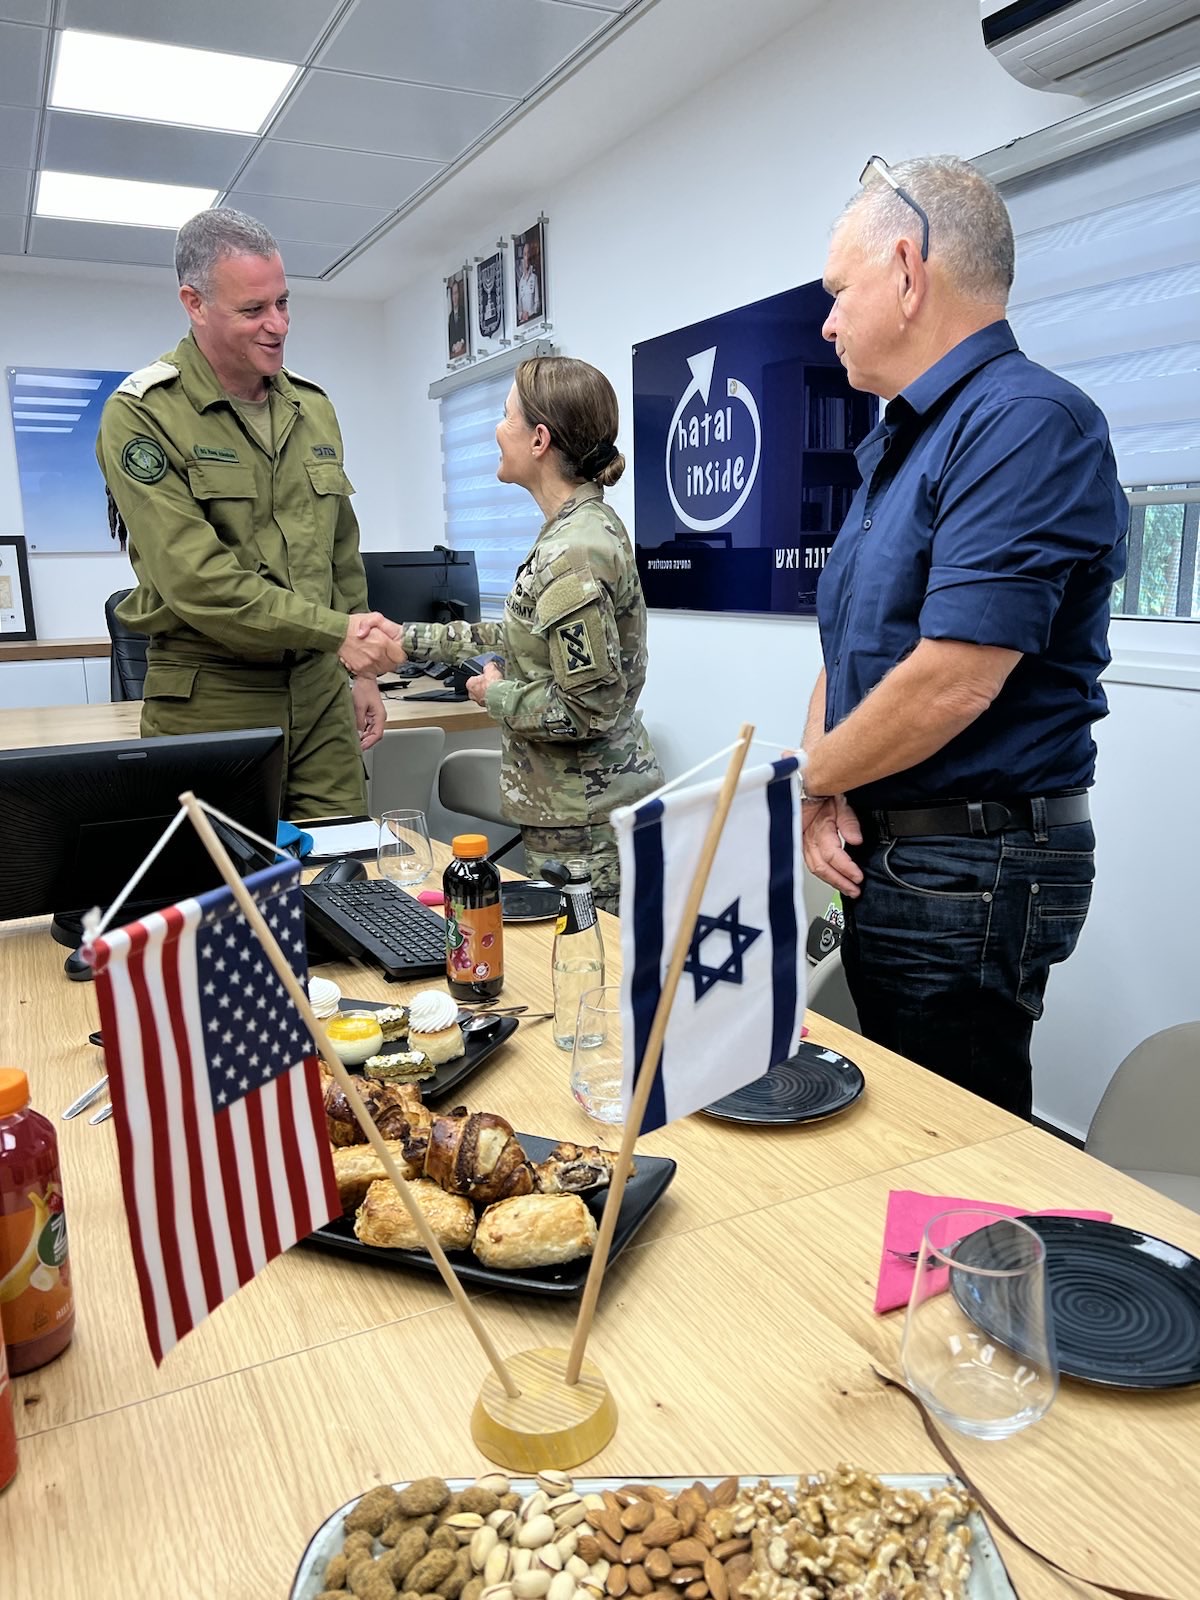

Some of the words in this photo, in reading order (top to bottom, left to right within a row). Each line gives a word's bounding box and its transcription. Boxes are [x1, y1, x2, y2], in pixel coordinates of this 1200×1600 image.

[678, 406, 732, 451] hatal
[687, 455, 745, 497] inside
[775, 548, 800, 569] ואש
[511, 600, 534, 618] ARMY
